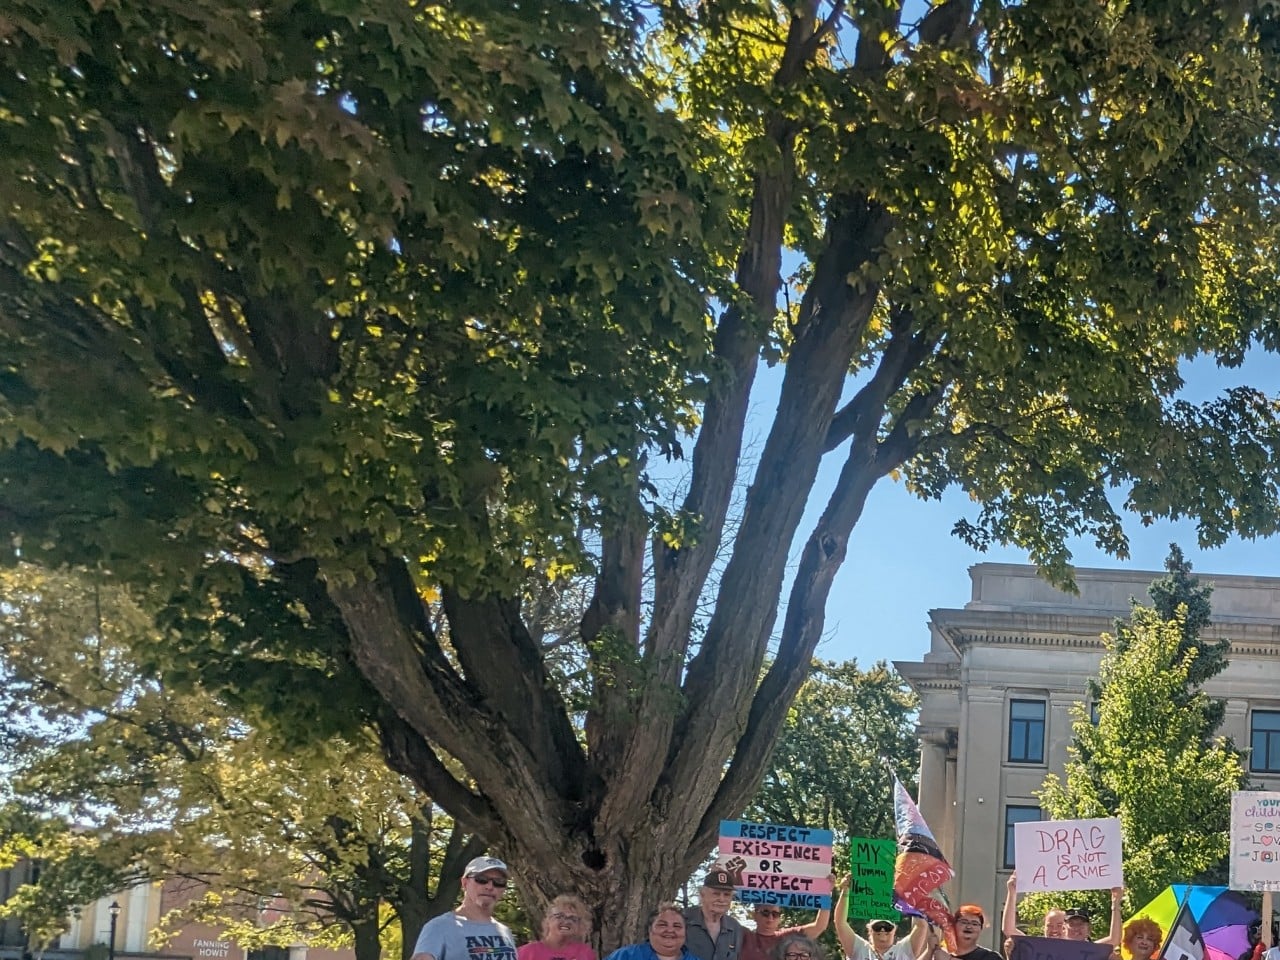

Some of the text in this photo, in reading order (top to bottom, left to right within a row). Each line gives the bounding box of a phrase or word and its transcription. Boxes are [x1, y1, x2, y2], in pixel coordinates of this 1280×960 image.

[740, 824, 811, 842] RESPECT
[1036, 826, 1105, 854] DRAG
[858, 842, 880, 864] MY
[1057, 852, 1106, 865] IS NOT
[759, 860, 783, 873] OR
[748, 875, 813, 891] EXPECT
[1033, 864, 1111, 887] A CRIME
[736, 890, 822, 908] ESiSTANCE
[193, 939, 229, 949] FANNING
[200, 949, 228, 957] HOWEY
